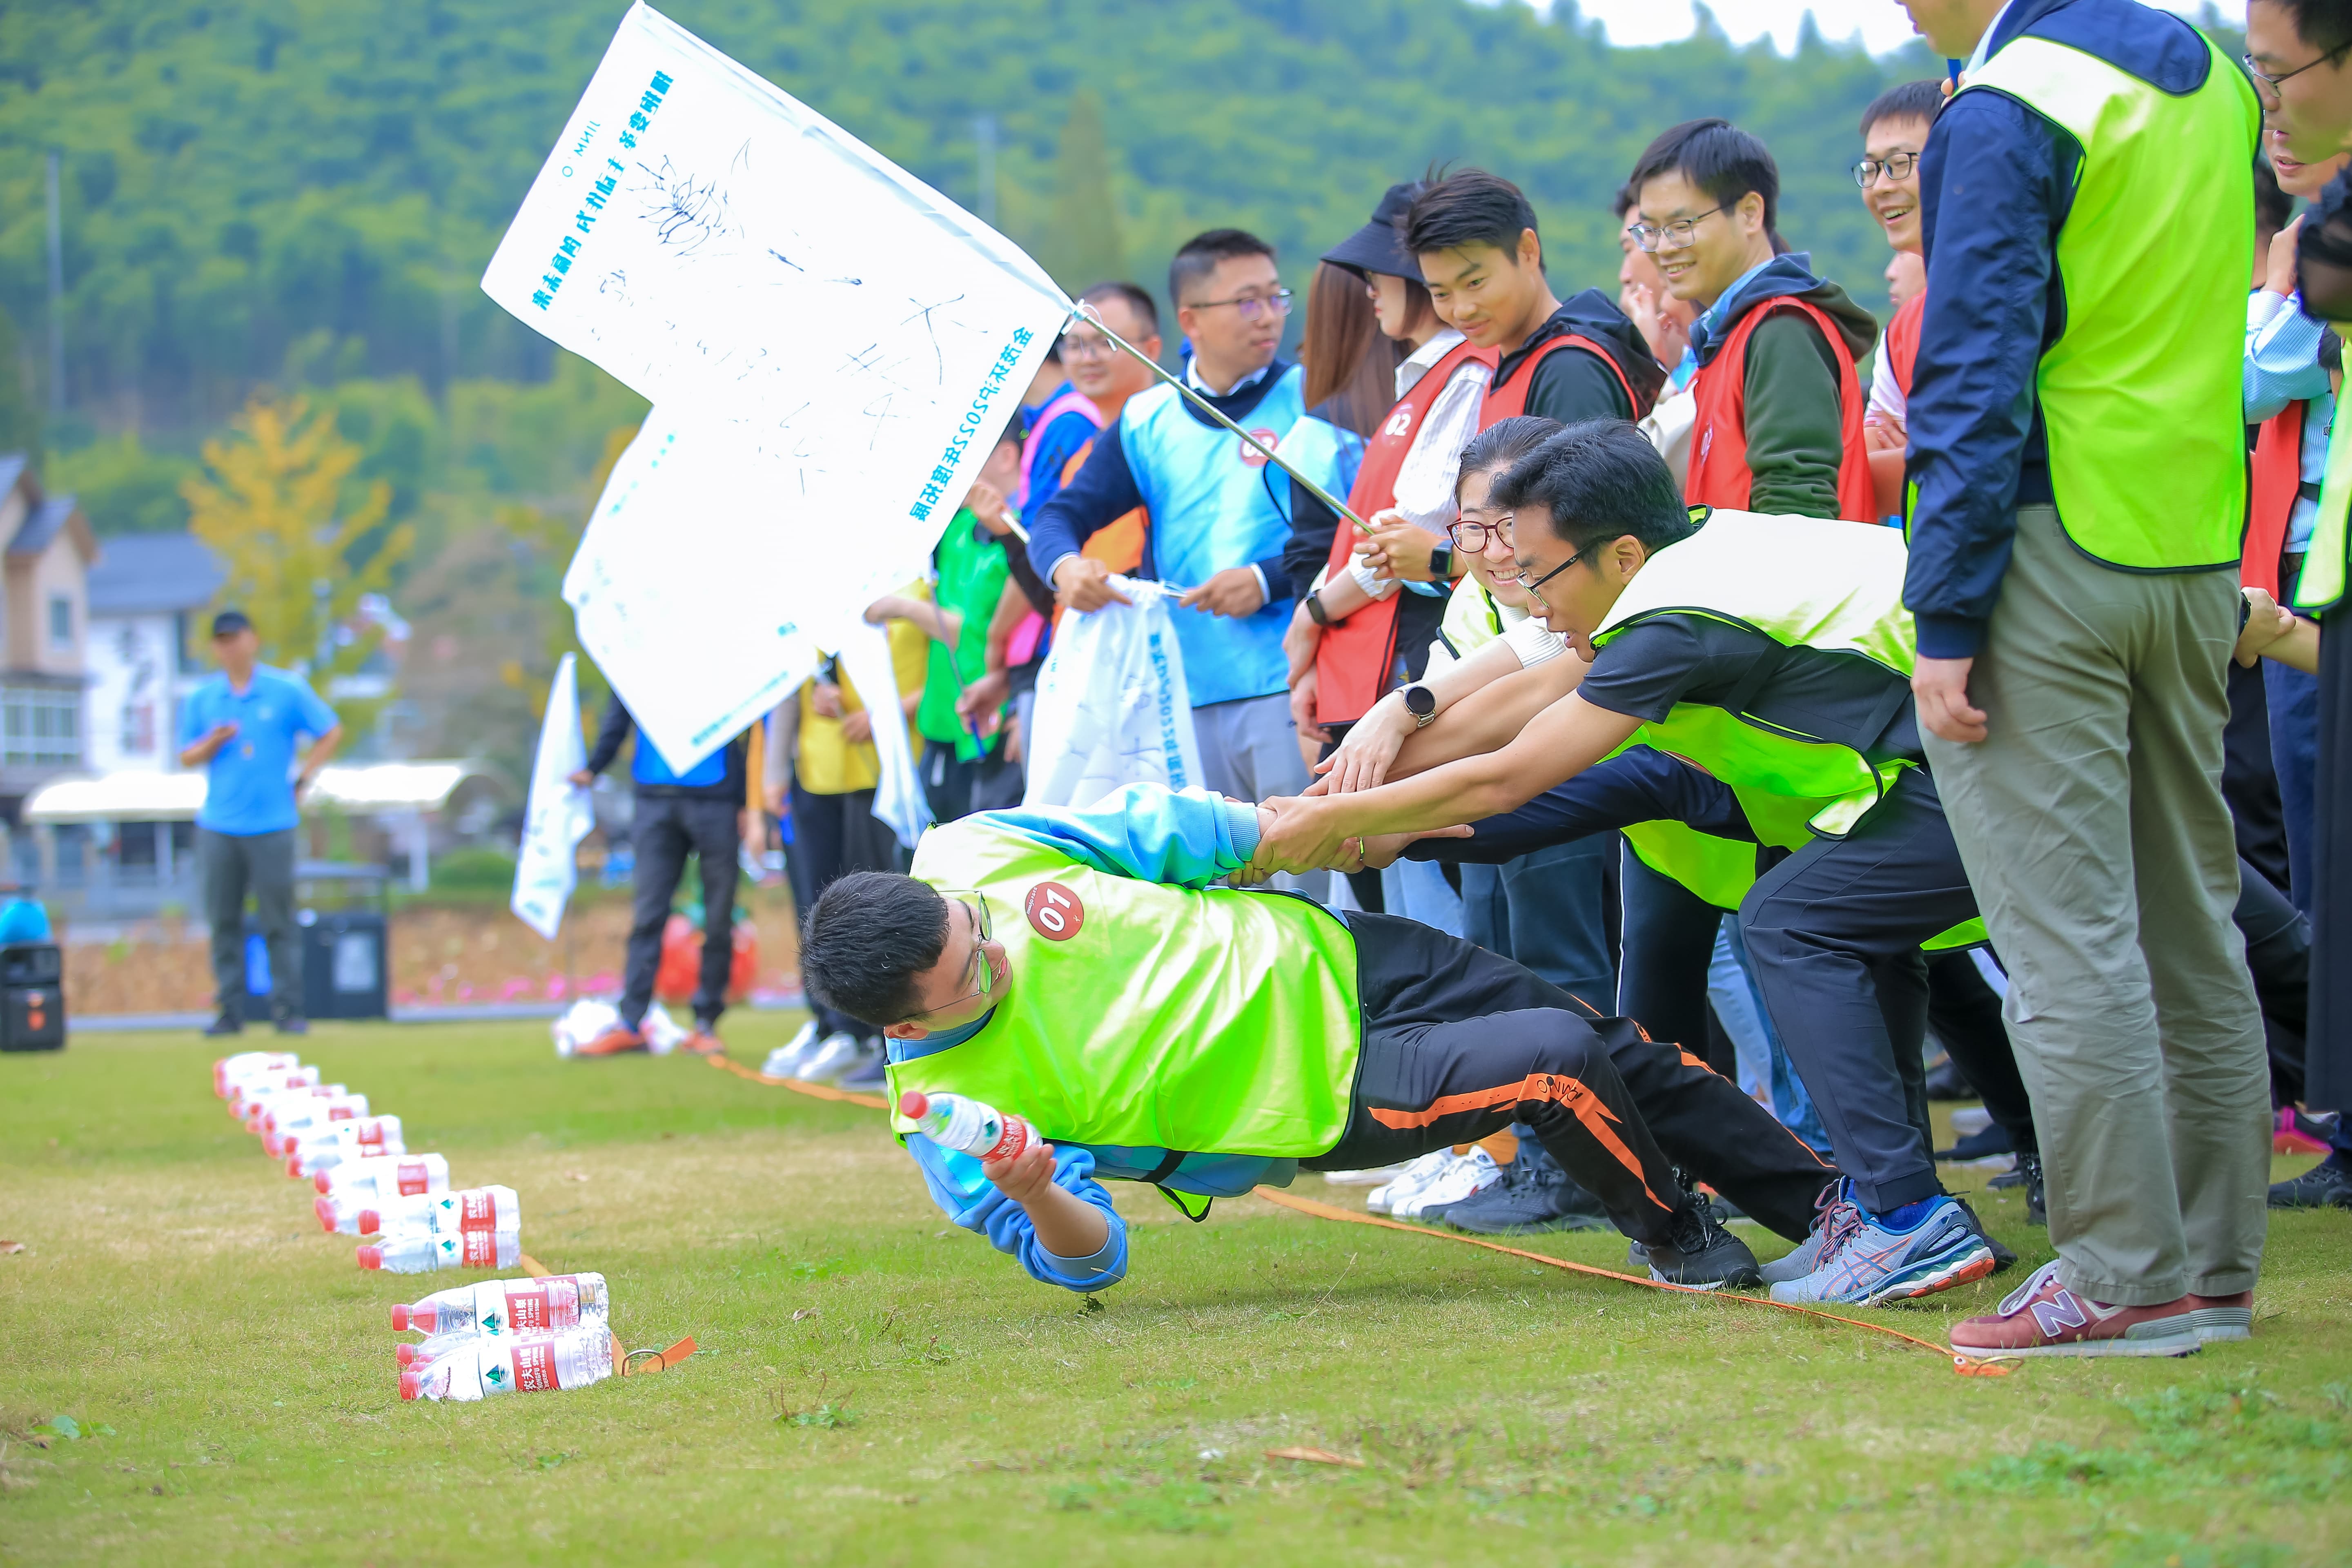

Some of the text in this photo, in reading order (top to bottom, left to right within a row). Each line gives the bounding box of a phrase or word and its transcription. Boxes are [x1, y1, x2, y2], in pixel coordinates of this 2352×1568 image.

[1385, 413, 1412, 437] 02
[1039, 888, 1071, 932] 01
[2029, 1289, 2086, 1338] N
[534, 1368, 544, 1388] NONGFU
